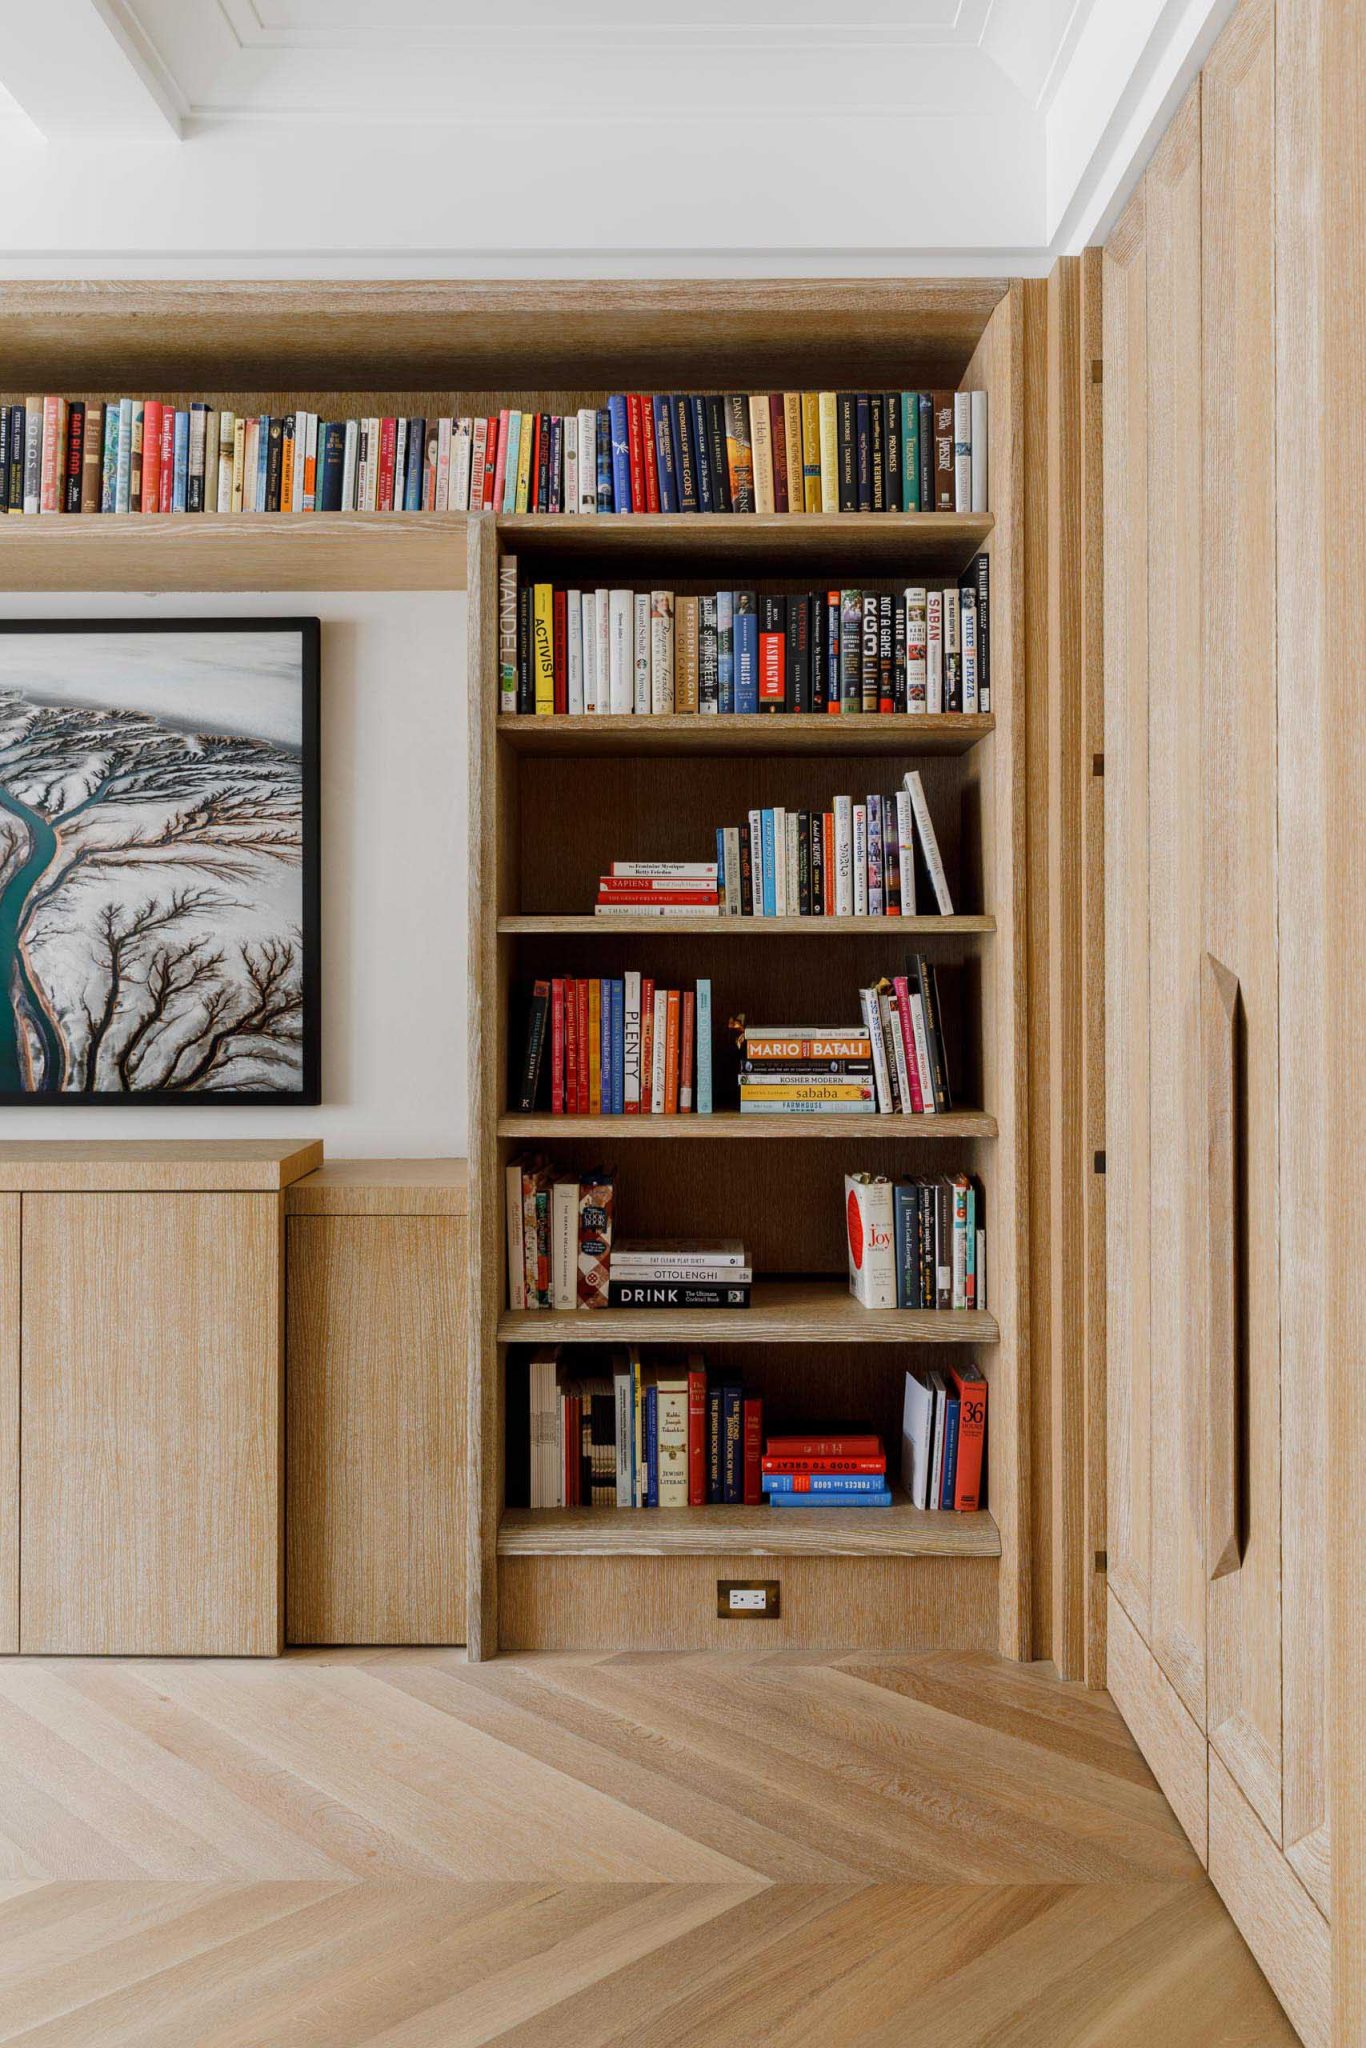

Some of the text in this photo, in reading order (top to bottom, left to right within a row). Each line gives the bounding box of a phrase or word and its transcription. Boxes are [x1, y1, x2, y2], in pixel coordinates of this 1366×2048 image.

[678, 401, 687, 441] WINDMILLS
[732, 397, 742, 419] DAN
[27, 416, 38, 469] SOROS
[163, 414, 172, 461] Unwifeable
[584, 414, 593, 460] Judy Blume
[756, 421, 767, 445] Help
[790, 415, 798, 438] SHELDON
[540, 432, 549, 464] OTHER
[681, 443, 688, 452] OF
[714, 436, 722, 473] SEABISCUIT
[791, 442, 799, 465] NOTHING
[906, 436, 916, 480] TREASURES
[936, 436, 954, 471] TAPESTRY
[474, 451, 484, 486] CYNTHIA
[683, 469, 692, 495] GODS
[792, 467, 800, 480] LASTS
[793, 481, 801, 502] FOREVER
[979, 559, 987, 600] TED WILLIAMS
[798, 602, 806, 650] VICTORIA
[863, 598, 877, 655] RG3
[880, 597, 891, 657] NOT A GAME
[895, 609, 904, 640] GOLDEN
[929, 599, 940, 640] SABAN
[535, 618, 553, 679] ACTIVIST
[638, 600, 646, 702] Howard Schultz Onward
[687, 603, 695, 704] PRESIDENT REAGAN
[703, 599, 714, 686] BRUCE SPRINGSTEEN
[966, 616, 974, 699] MIKE PIAZZA
[661, 624, 673, 702] Benjamin Franklin
[740, 653, 750, 684] DOUGLASS
[766, 636, 778, 693] WASHINGTON
[678, 658, 687, 704] CANNON
[856, 811, 864, 862] Unbelievable
[626, 1011, 638, 1079] PLENTY
[750, 1043, 862, 1056] MARIO BATALI
[888, 1053, 897, 1081] COOKER
[796, 1088, 838, 1098] sababa
[654, 1271, 717, 1280] OTTOLENGHI
[621, 1289, 678, 1302] DRINK
[725, 1417, 733, 1440] JEWISH
[963, 1402, 984, 1424] 36
[711, 1457, 718, 1466] OF
[726, 1458, 733, 1469] OF
